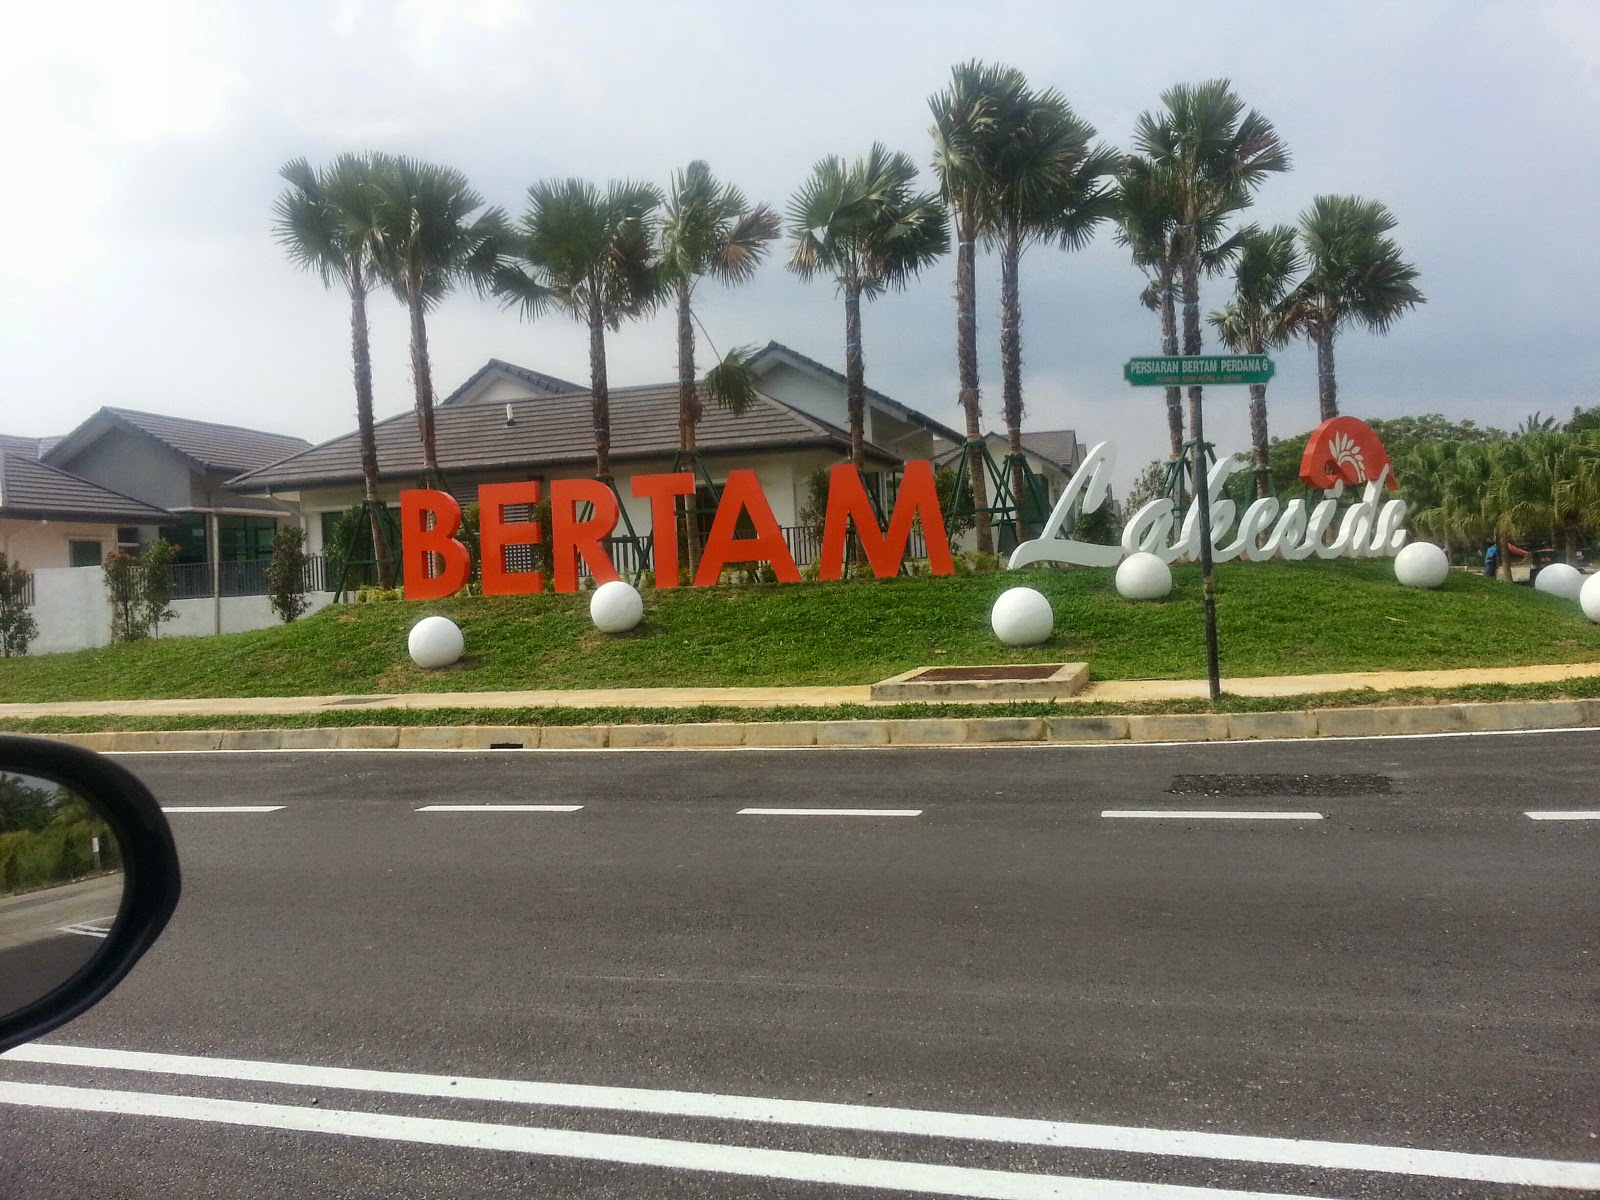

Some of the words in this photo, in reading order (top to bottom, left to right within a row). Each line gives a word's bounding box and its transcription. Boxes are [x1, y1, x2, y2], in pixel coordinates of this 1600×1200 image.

[1130, 361, 1179, 374] PERSIARAN
[1181, 360, 1217, 373] BERTAM
[1220, 359, 1261, 373] PERDANA
[1262, 358, 1268, 371] 6
[400, 459, 955, 600] BERTAM
[1008, 440, 1407, 570] Lakeside
